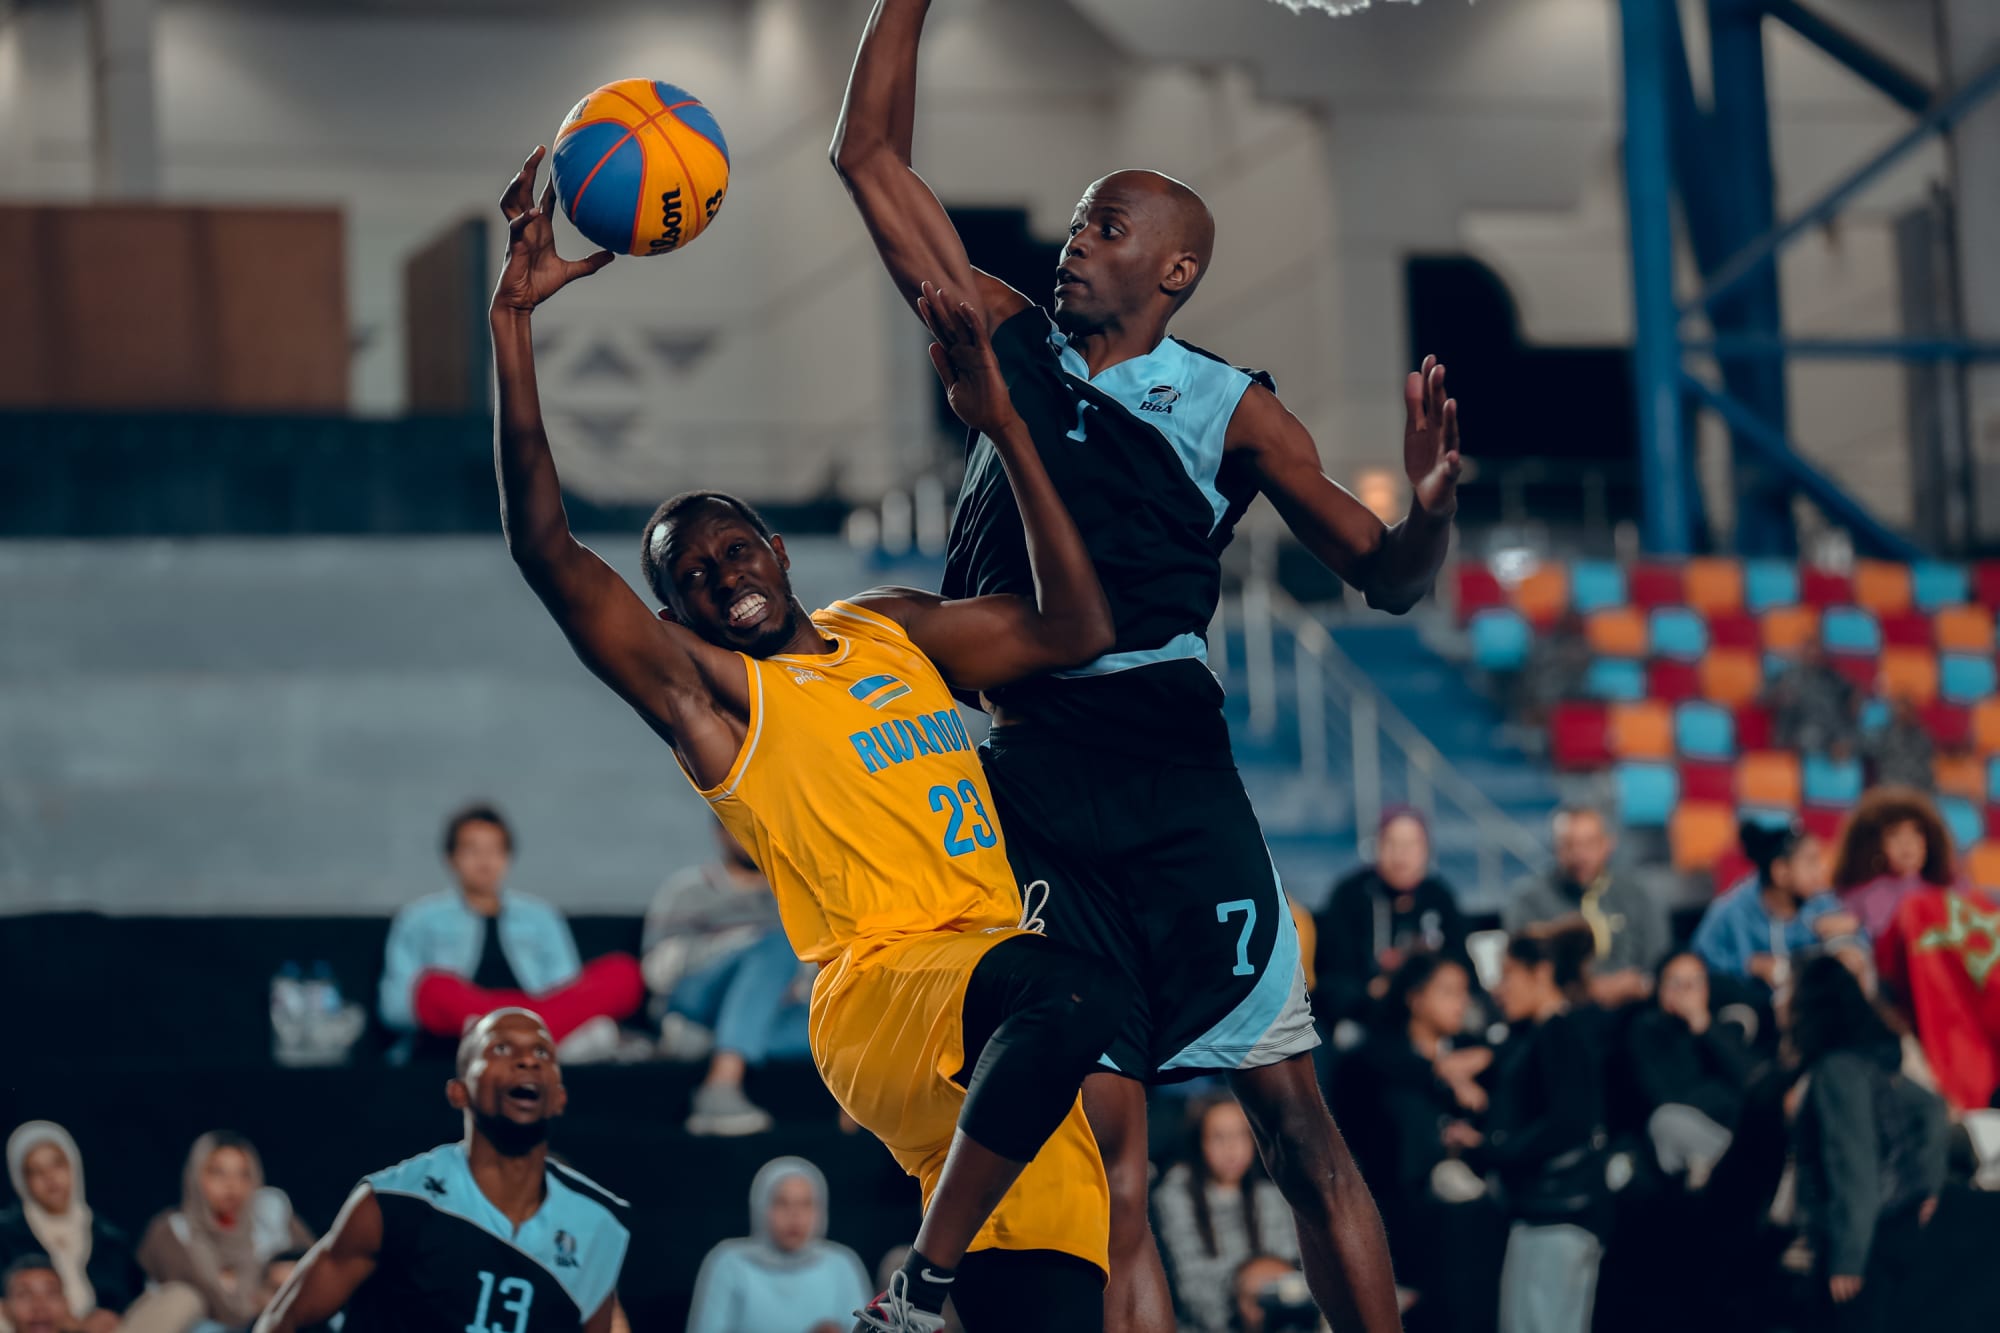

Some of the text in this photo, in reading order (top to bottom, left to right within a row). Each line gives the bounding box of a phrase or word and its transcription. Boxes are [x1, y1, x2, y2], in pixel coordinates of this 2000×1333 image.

[645, 187, 682, 256] ilson
[848, 708, 971, 774] RWANDA
[928, 779, 997, 857] 23
[1216, 898, 1257, 976] 7
[465, 1270, 534, 1333] 13
